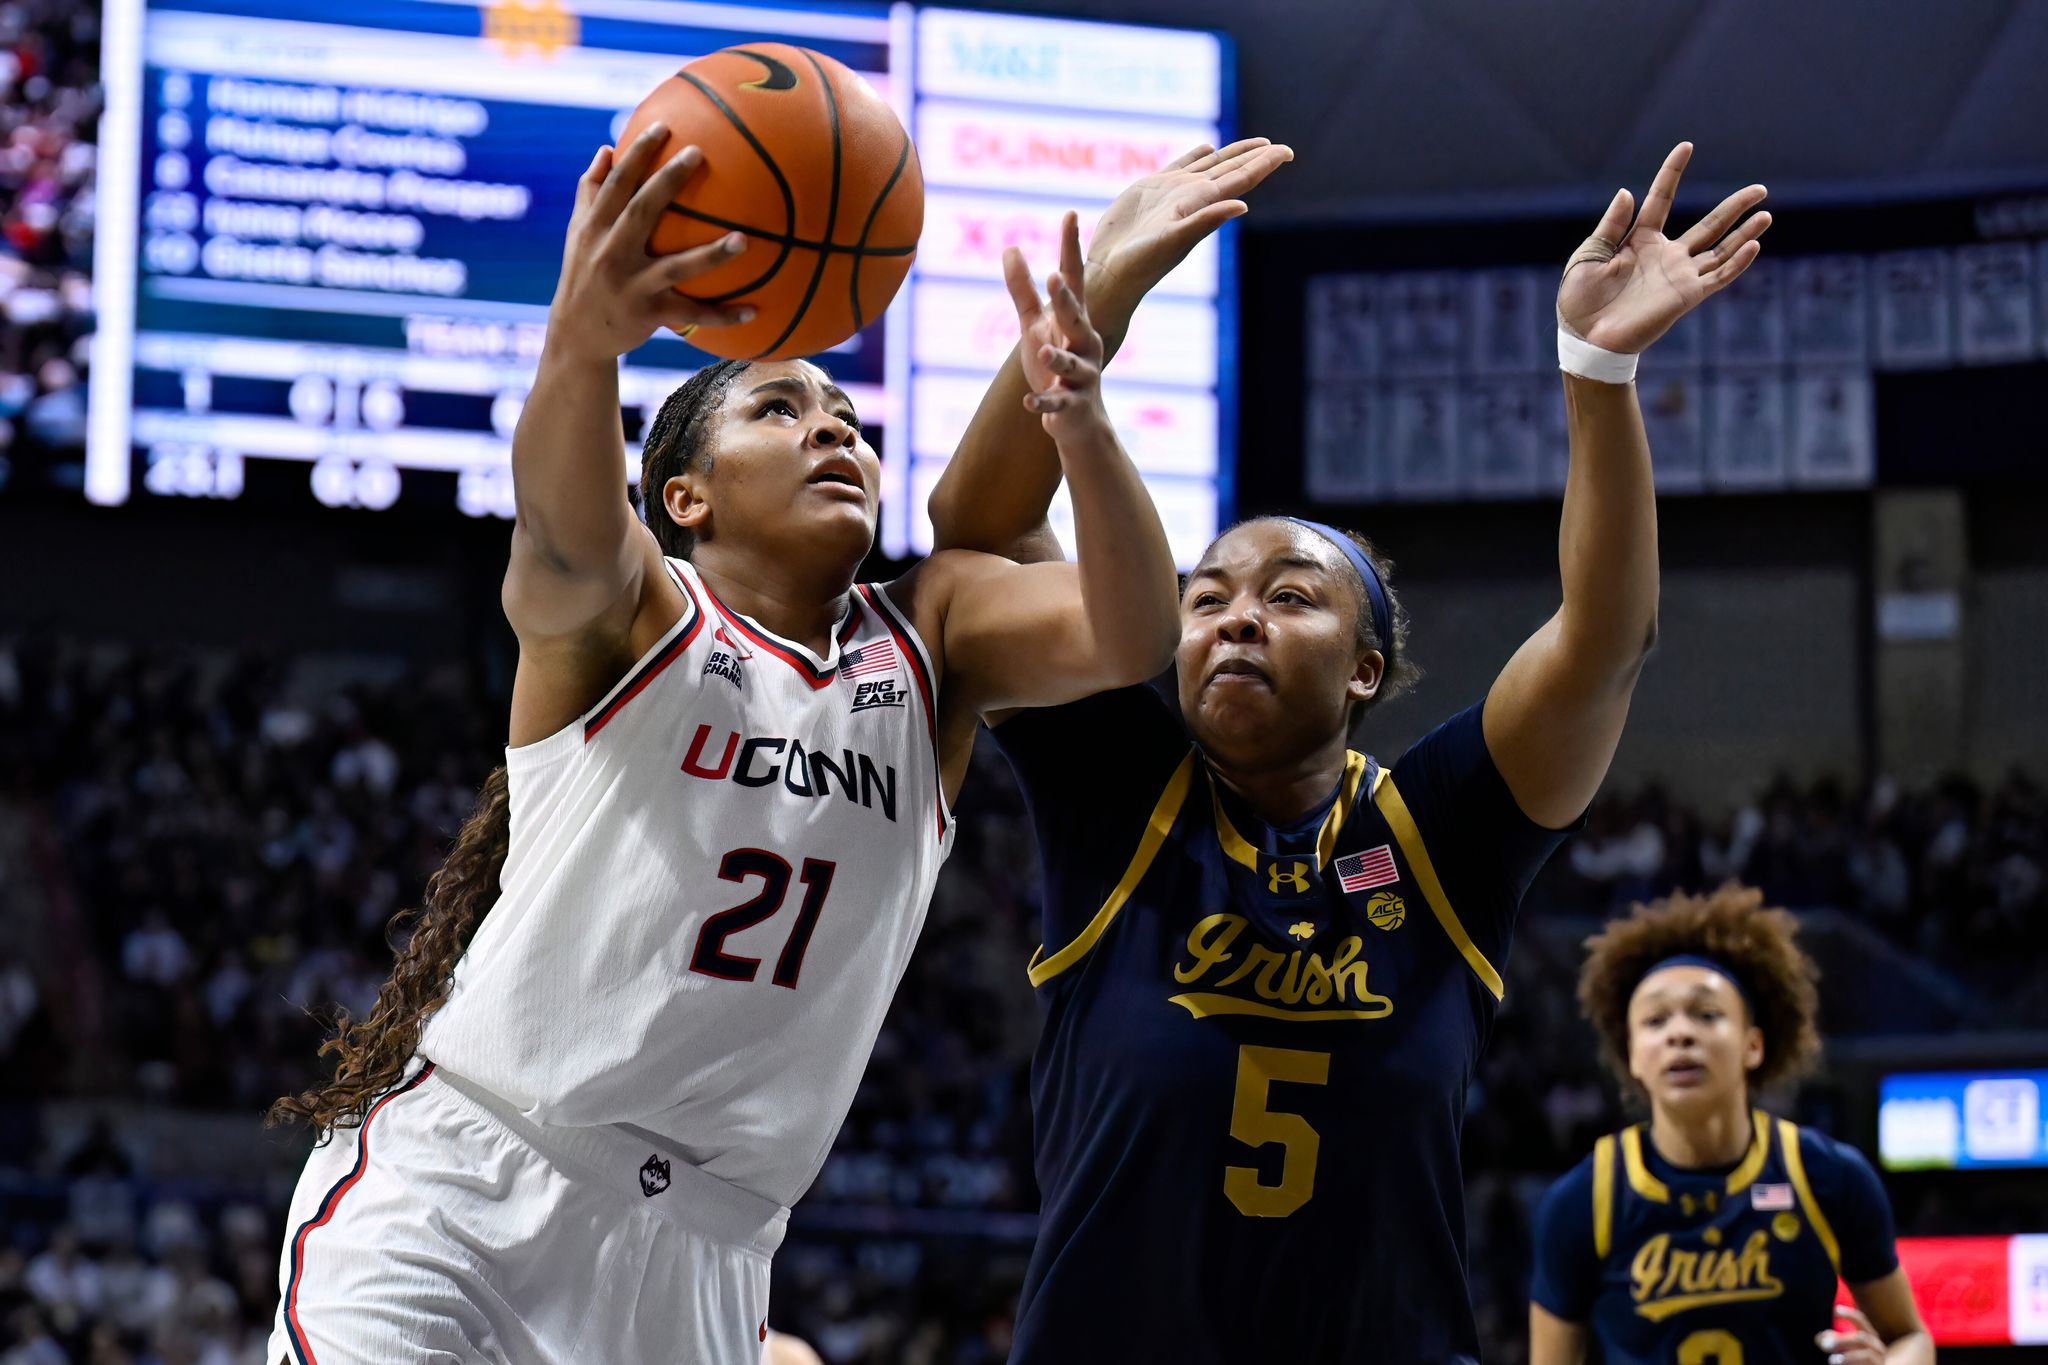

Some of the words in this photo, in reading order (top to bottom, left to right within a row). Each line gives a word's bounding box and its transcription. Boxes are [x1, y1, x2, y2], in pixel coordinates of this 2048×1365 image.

[703, 663, 742, 692] CHANG
[709, 651, 730, 666] BE
[731, 659, 742, 679] TH
[855, 679, 895, 695] BIG
[852, 690, 908, 708] EAST
[680, 723, 897, 822] UCONN
[688, 847, 837, 990] 21
[1371, 899, 1403, 917] ACC
[1170, 912, 1394, 1008] Irish
[1223, 1044, 1331, 1218] 5
[1630, 1229, 1785, 1304] Irish
